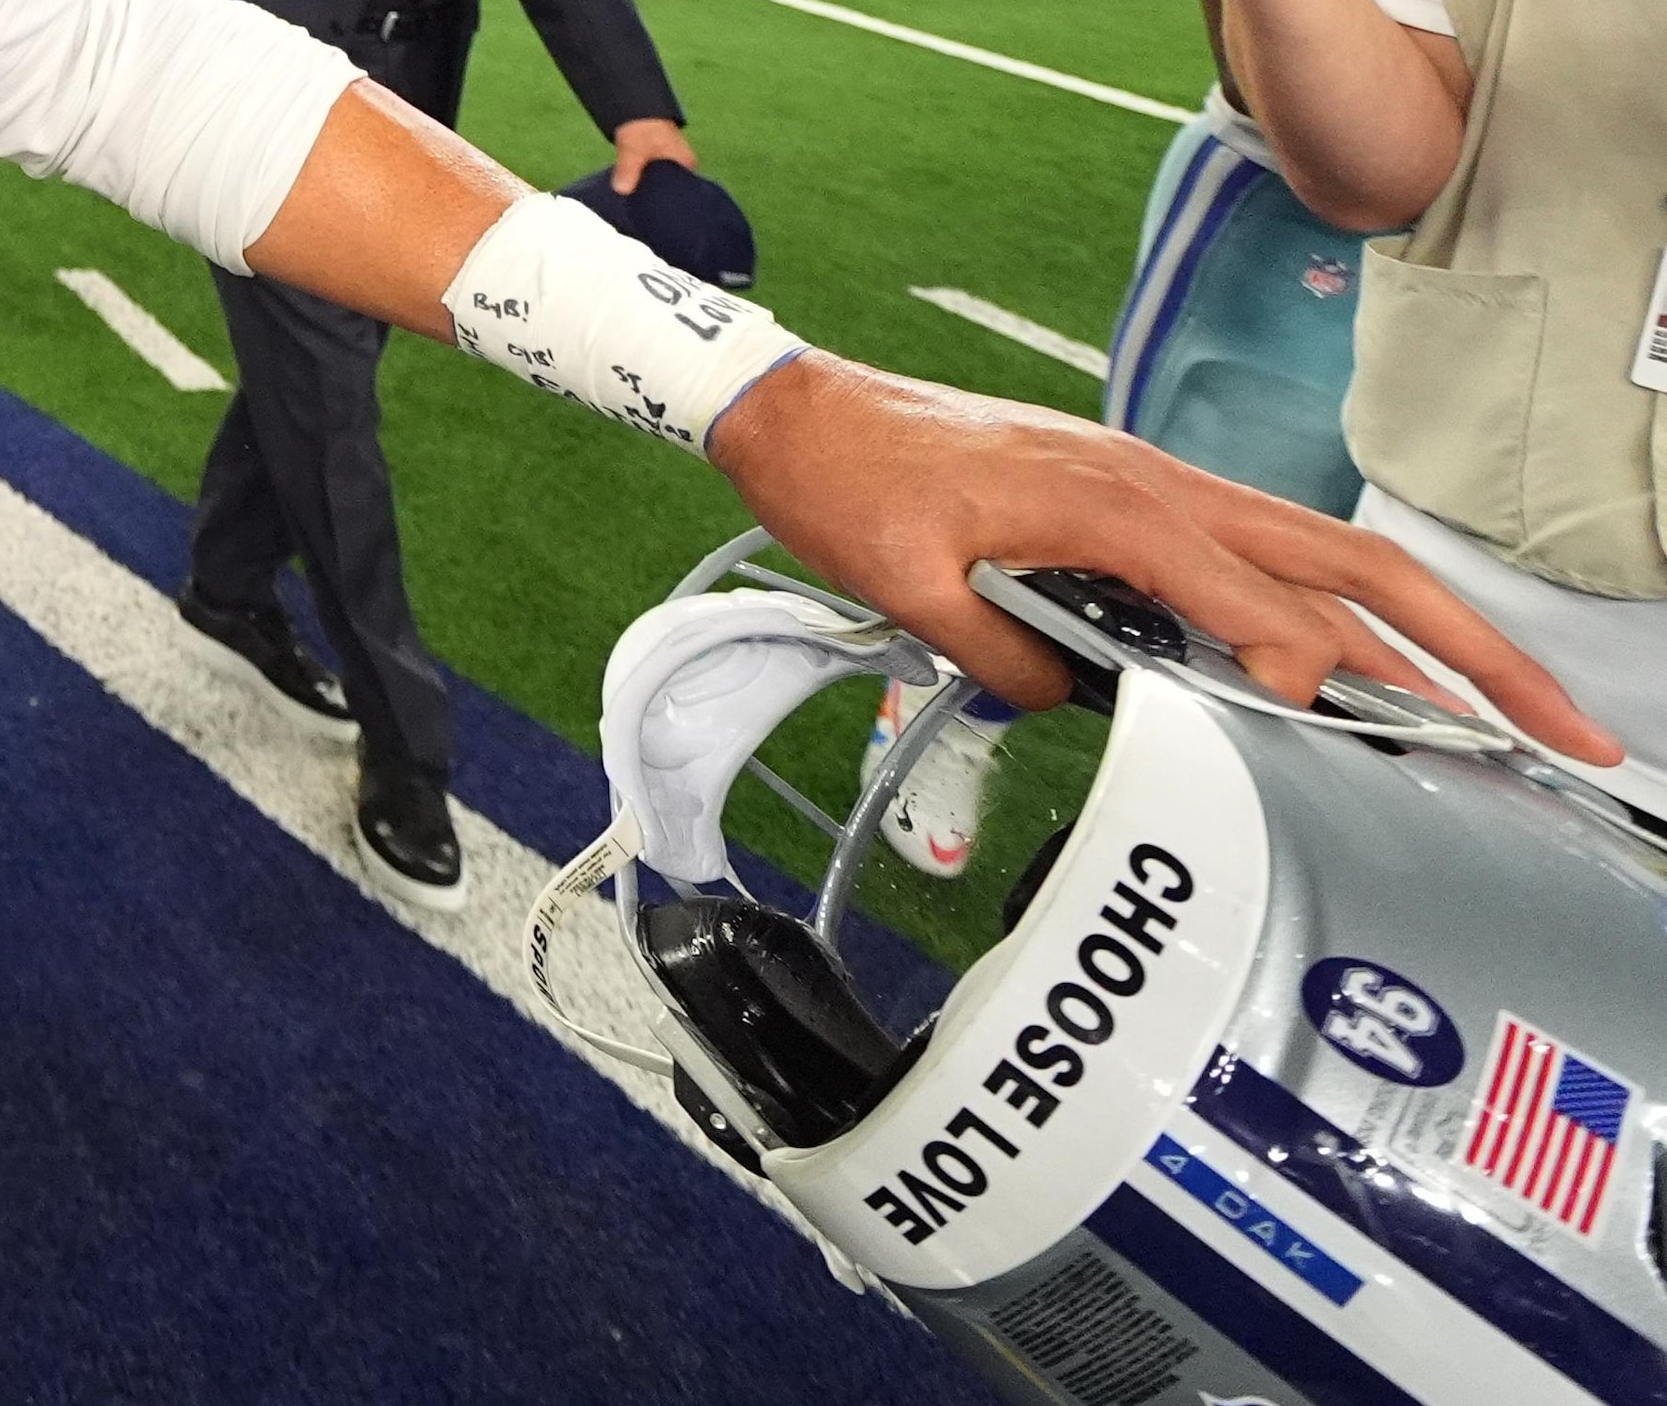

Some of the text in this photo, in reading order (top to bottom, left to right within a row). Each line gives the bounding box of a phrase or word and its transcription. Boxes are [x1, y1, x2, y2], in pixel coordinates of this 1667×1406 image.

[982, 843, 1194, 1130] CHOOSE
[1321, 967, 1441, 1080] 94
[863, 1106, 1022, 1246] LOVE
[1158, 1154, 1316, 1270] 4 DAK
